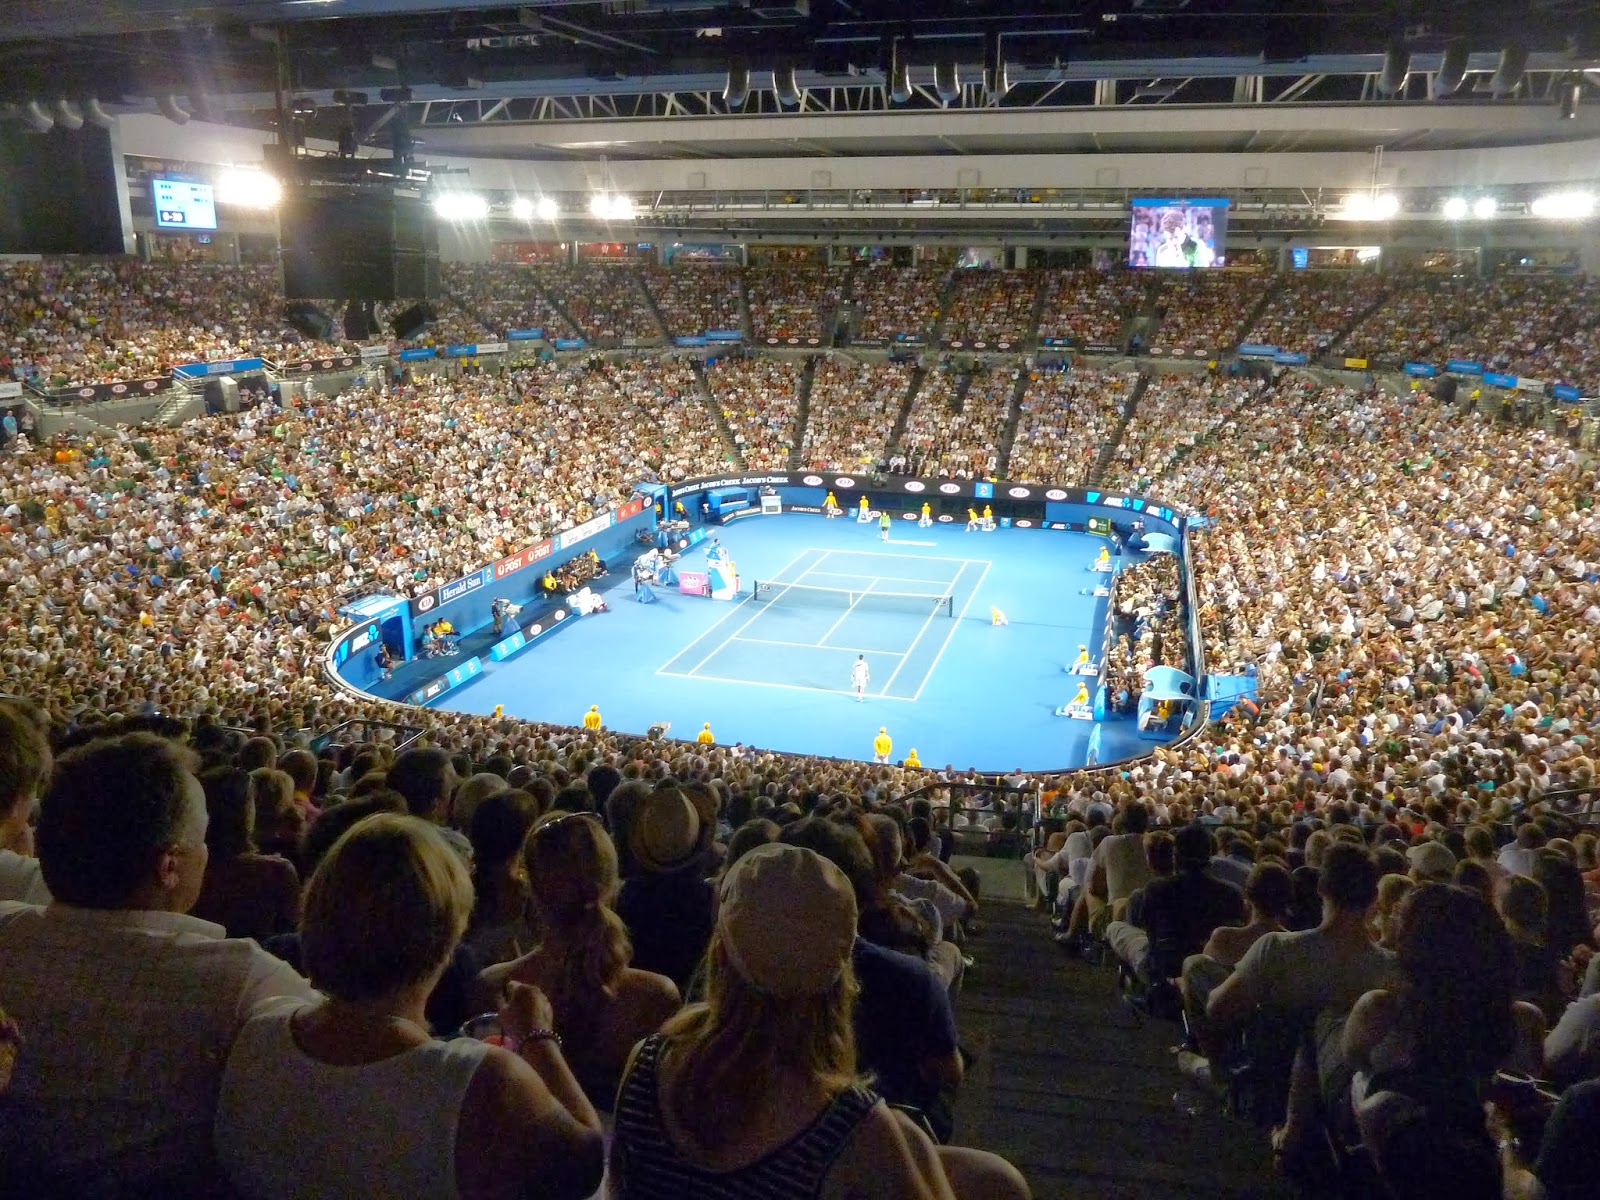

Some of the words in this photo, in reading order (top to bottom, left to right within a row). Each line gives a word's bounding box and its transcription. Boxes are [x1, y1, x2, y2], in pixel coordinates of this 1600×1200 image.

[534, 544, 551, 560] POST
[504, 557, 523, 574] POST
[443, 580, 467, 600] Herald
[467, 577, 481, 589] Sun
